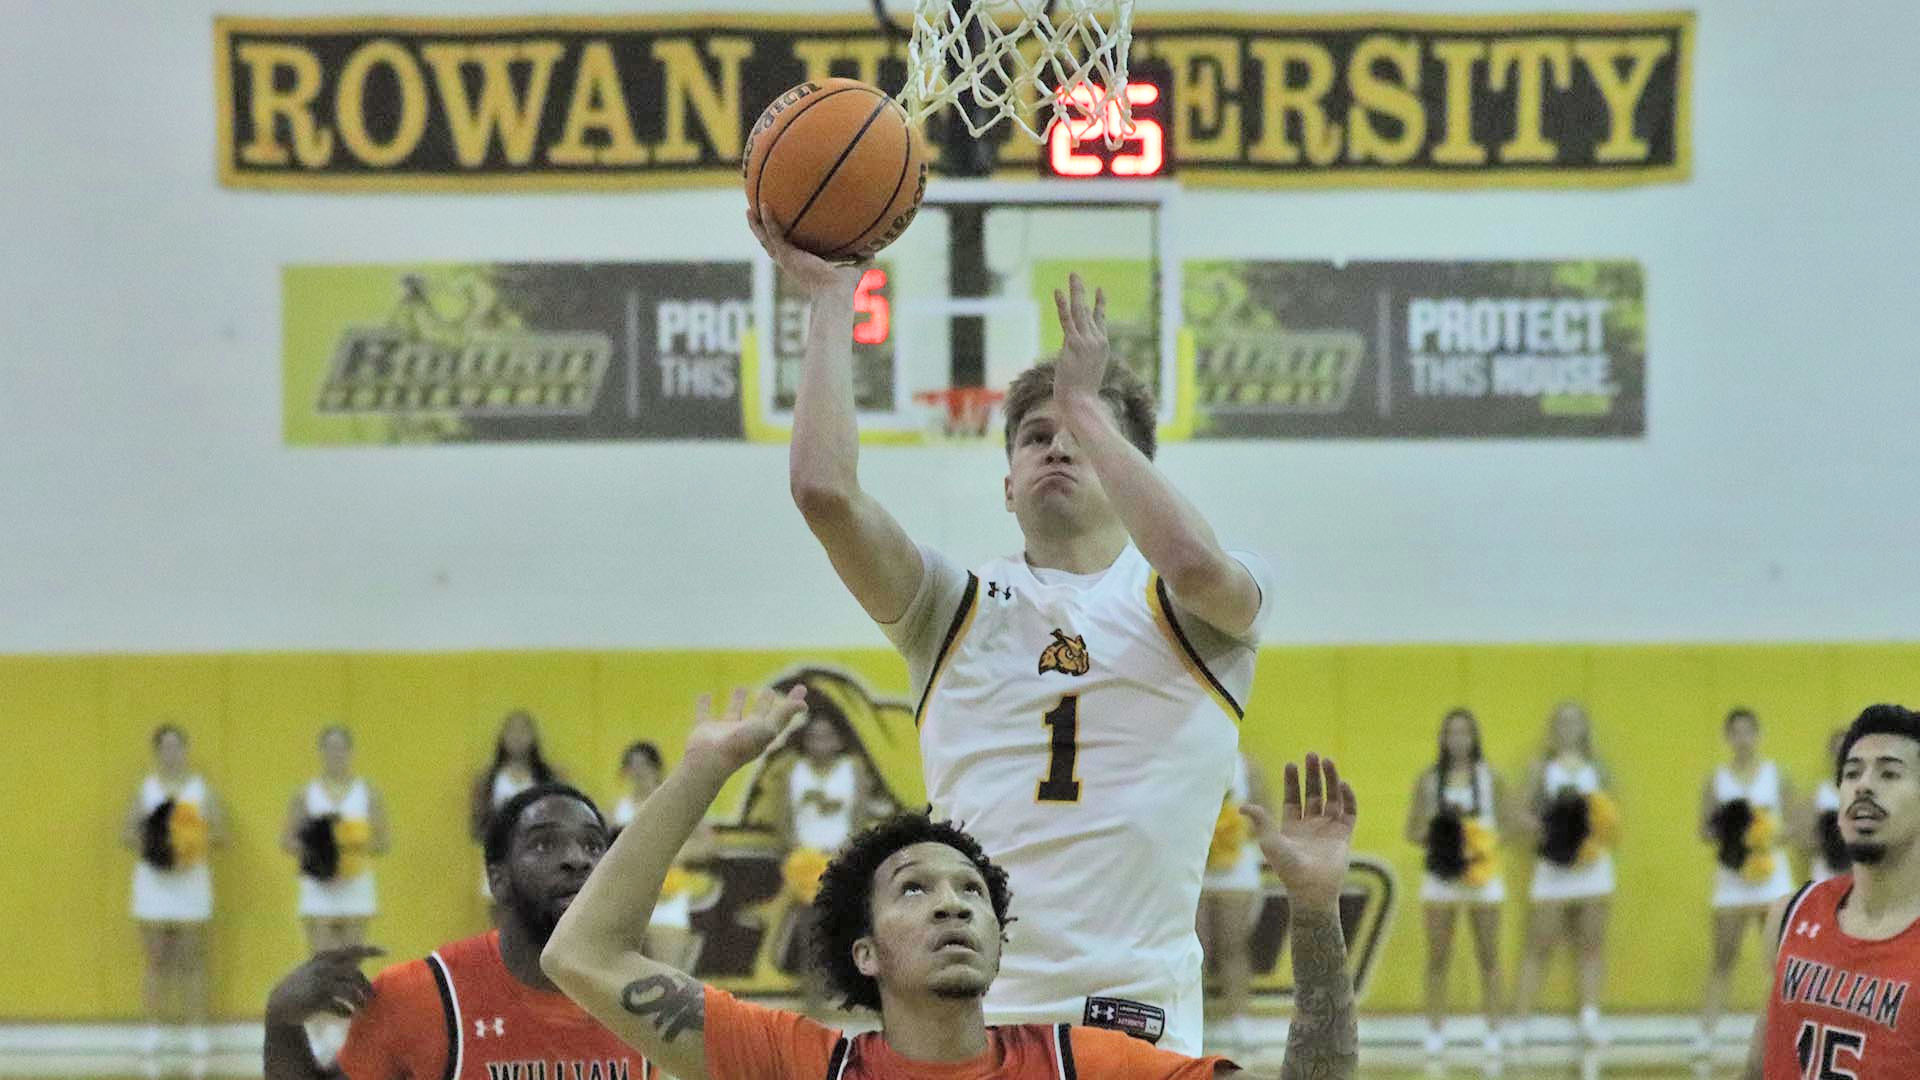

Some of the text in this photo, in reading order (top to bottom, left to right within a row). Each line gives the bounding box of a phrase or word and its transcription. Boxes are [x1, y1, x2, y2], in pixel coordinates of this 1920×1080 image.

[237, 39, 755, 168] ROWAN
[1051, 82, 1164, 176] 25
[1408, 297, 1610, 352] PROTECT
[658, 353, 736, 398] THIS
[1411, 353, 1487, 397] THIS
[1034, 688, 1084, 805] 1
[1782, 955, 1910, 1032] WILLIAM
